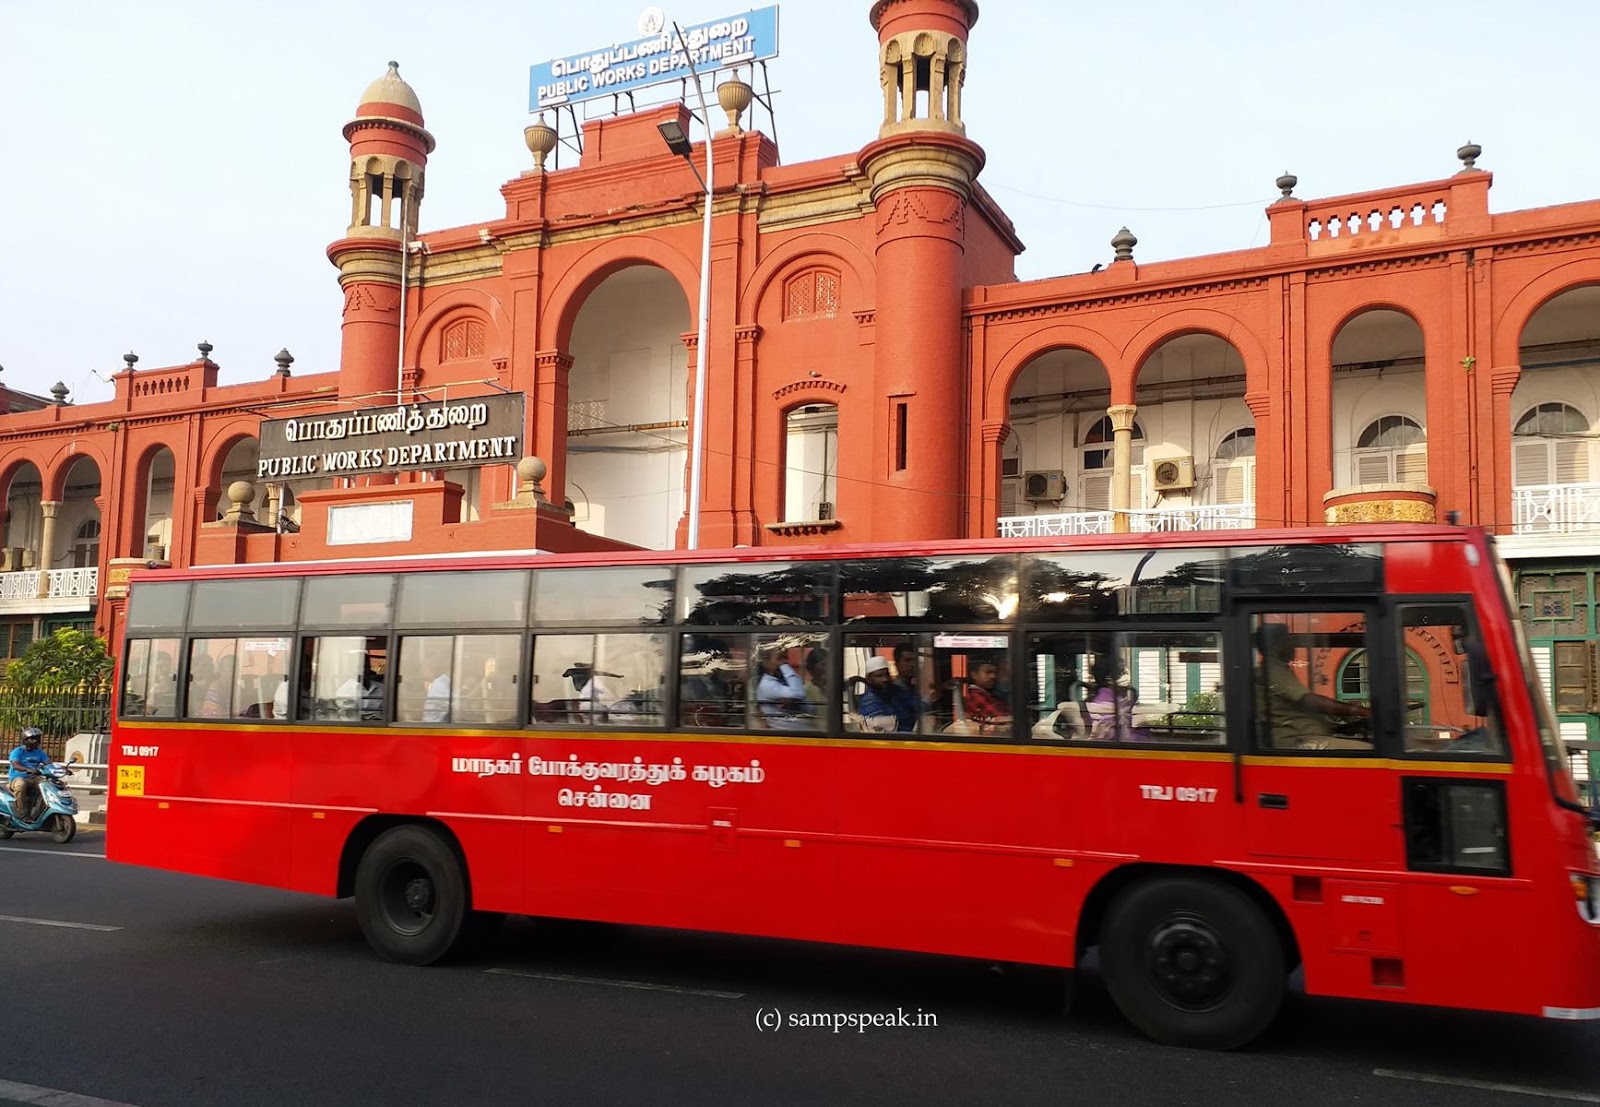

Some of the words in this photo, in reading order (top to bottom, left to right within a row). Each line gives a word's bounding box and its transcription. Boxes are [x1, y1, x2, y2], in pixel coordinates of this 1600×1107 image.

[537, 76, 589, 100] PUBLIC
[592, 61, 646, 89] WORKS
[649, 35, 755, 75] DEPARTMENT
[285, 402, 487, 442] பொதுப்பணித்துறை
[257, 453, 317, 477] PUBLIC
[322, 448, 383, 472] WORKS
[387, 436, 516, 466] DEPARTMENT
[452, 752, 522, 778] மாநகர்
[528, 753, 687, 785] போக்குவரத்துக்
[691, 759, 765, 788] கழகம்
[558, 785, 653, 810] சென்னை
[1139, 784, 1173, 801] TRJ
[1175, 786, 1218, 803] 0917
